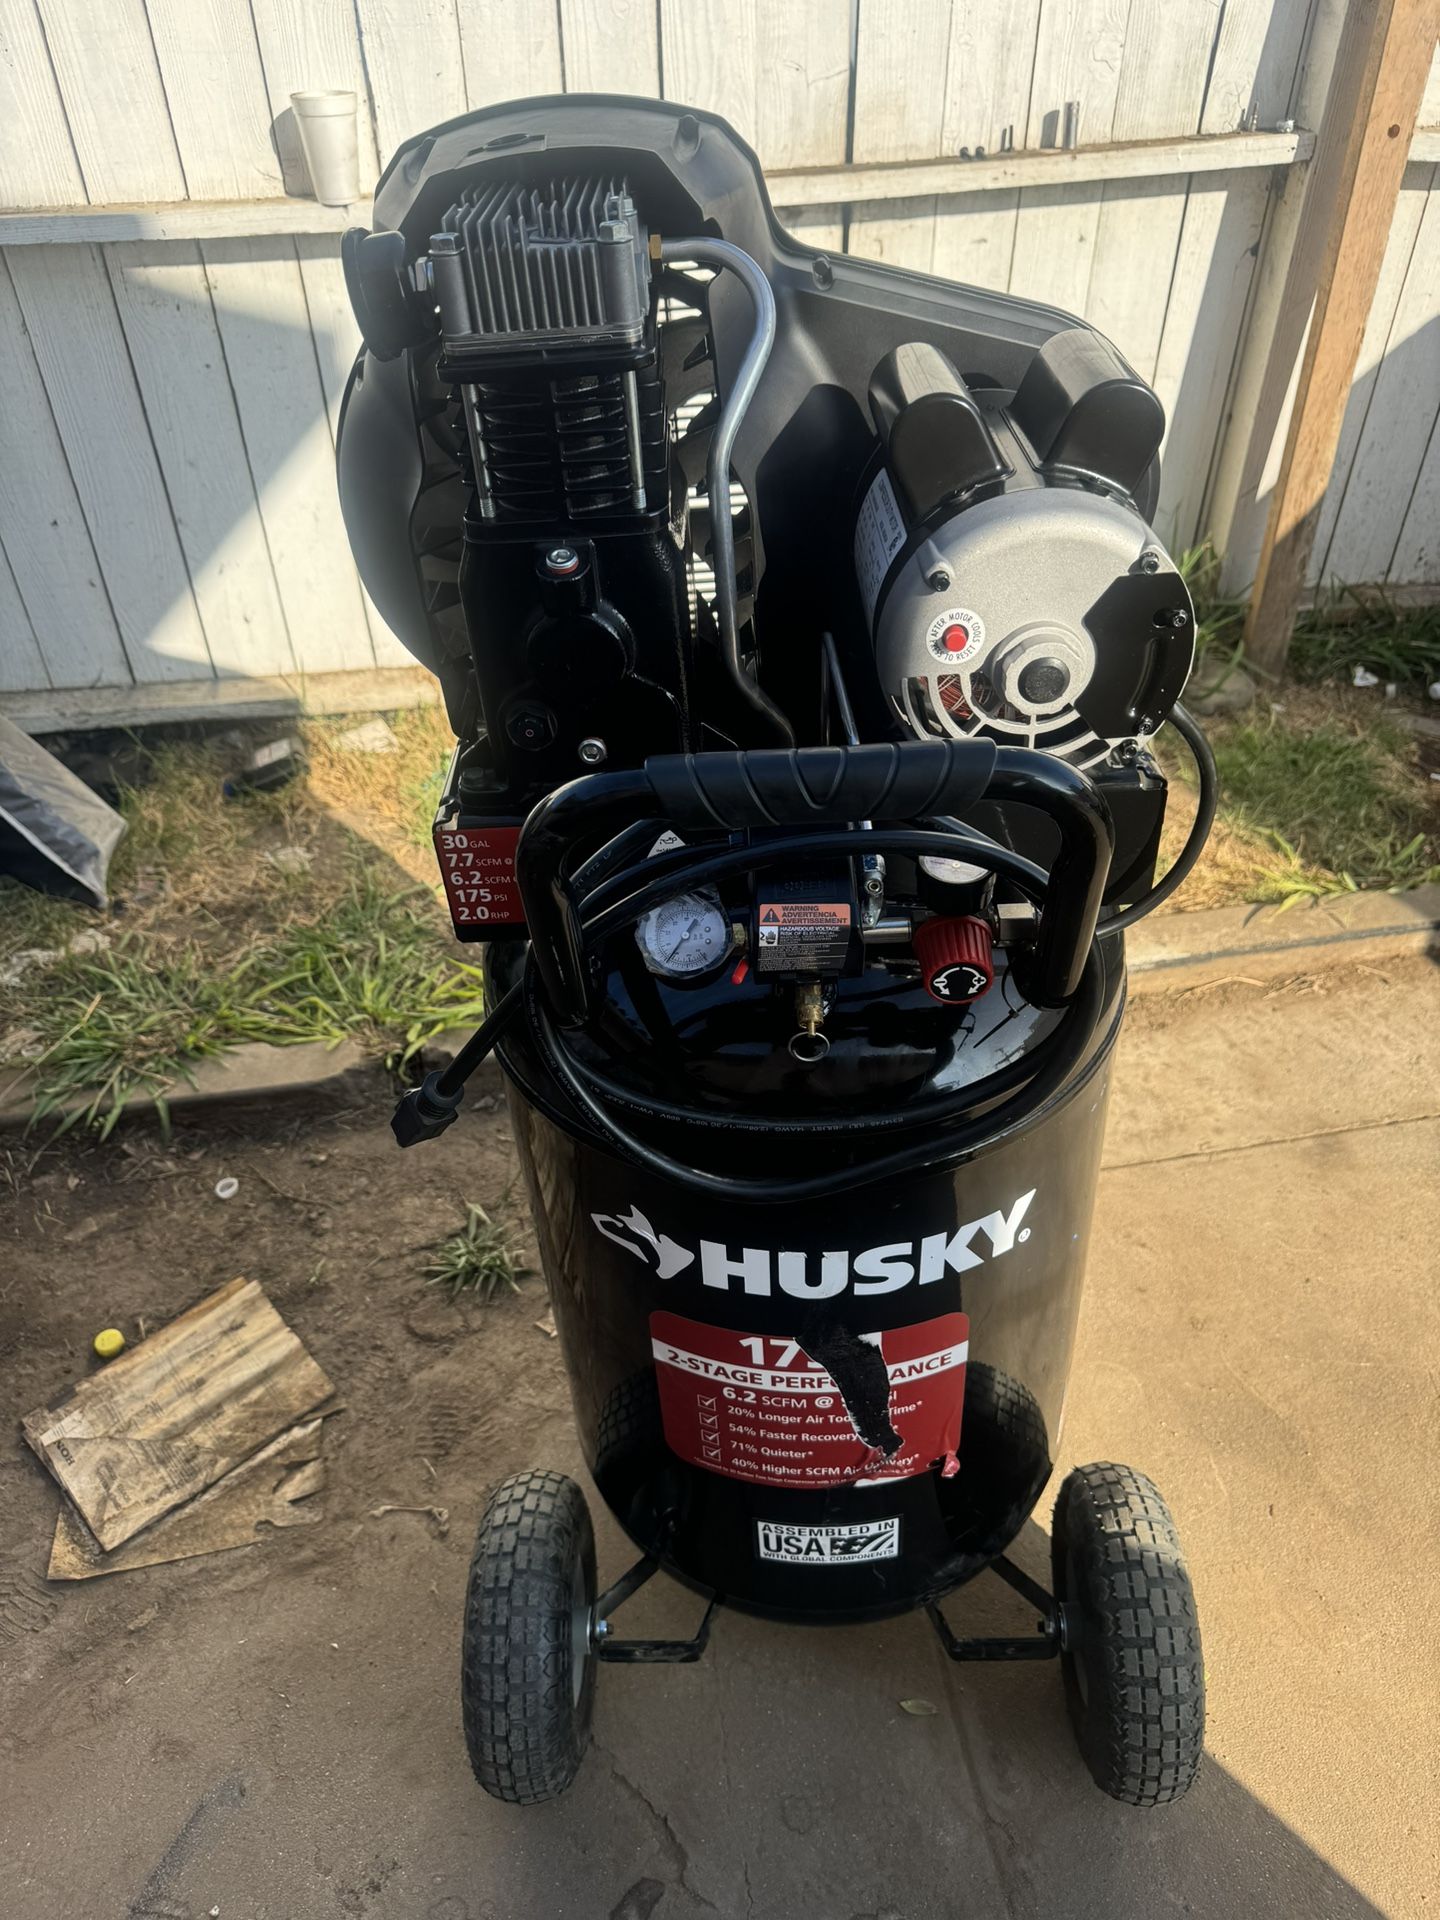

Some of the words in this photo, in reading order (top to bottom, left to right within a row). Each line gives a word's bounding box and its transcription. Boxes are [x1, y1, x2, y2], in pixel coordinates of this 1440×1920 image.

[931, 617, 947, 637] AFTER
[949, 612, 973, 623] MOTOR
[971, 622, 981, 643] COOLS
[944, 653, 954, 661] TO
[956, 644, 976, 661] RESET
[442, 834, 468, 849] 30
[470, 840, 490, 848] GAL
[445, 853, 474, 867] 7.7
[475, 858, 502, 866] SCFM
[450, 871, 483, 886] 6.2
[484, 876, 511, 884] SCFM
[455, 889, 492, 903] 175
[458, 906, 489, 921] 2.0
[491, 911, 510, 919] RHP
[700, 1188, 1037, 1299] HUSKY
[668, 1349, 762, 1385] 2-STAGE
[722, 1387, 757, 1404] 6.2
[762, 1395, 807, 1408] SCFM
[815, 1396, 834, 1408] @
[728, 1405, 755, 1419] 20%
[759, 1411, 802, 1425] Longer
[805, 1415, 824, 1424] Air
[728, 1423, 756, 1436] 54%
[760, 1429, 798, 1441] Faster
[801, 1432, 858, 1442] Recovery
[730, 1440, 757, 1454] 71%
[731, 1458, 759, 1470] 40%
[762, 1463, 802, 1475] Higher
[806, 1467, 840, 1476] SCFM
[762, 1523, 870, 1537] ASSEMBLED
[878, 1521, 895, 1531] IN
[763, 1532, 825, 1556] USA
[763, 1551, 787, 1560] WITH
[790, 1554, 826, 1562] GLOBAL
[829, 1549, 894, 1562] COMPONENTS
